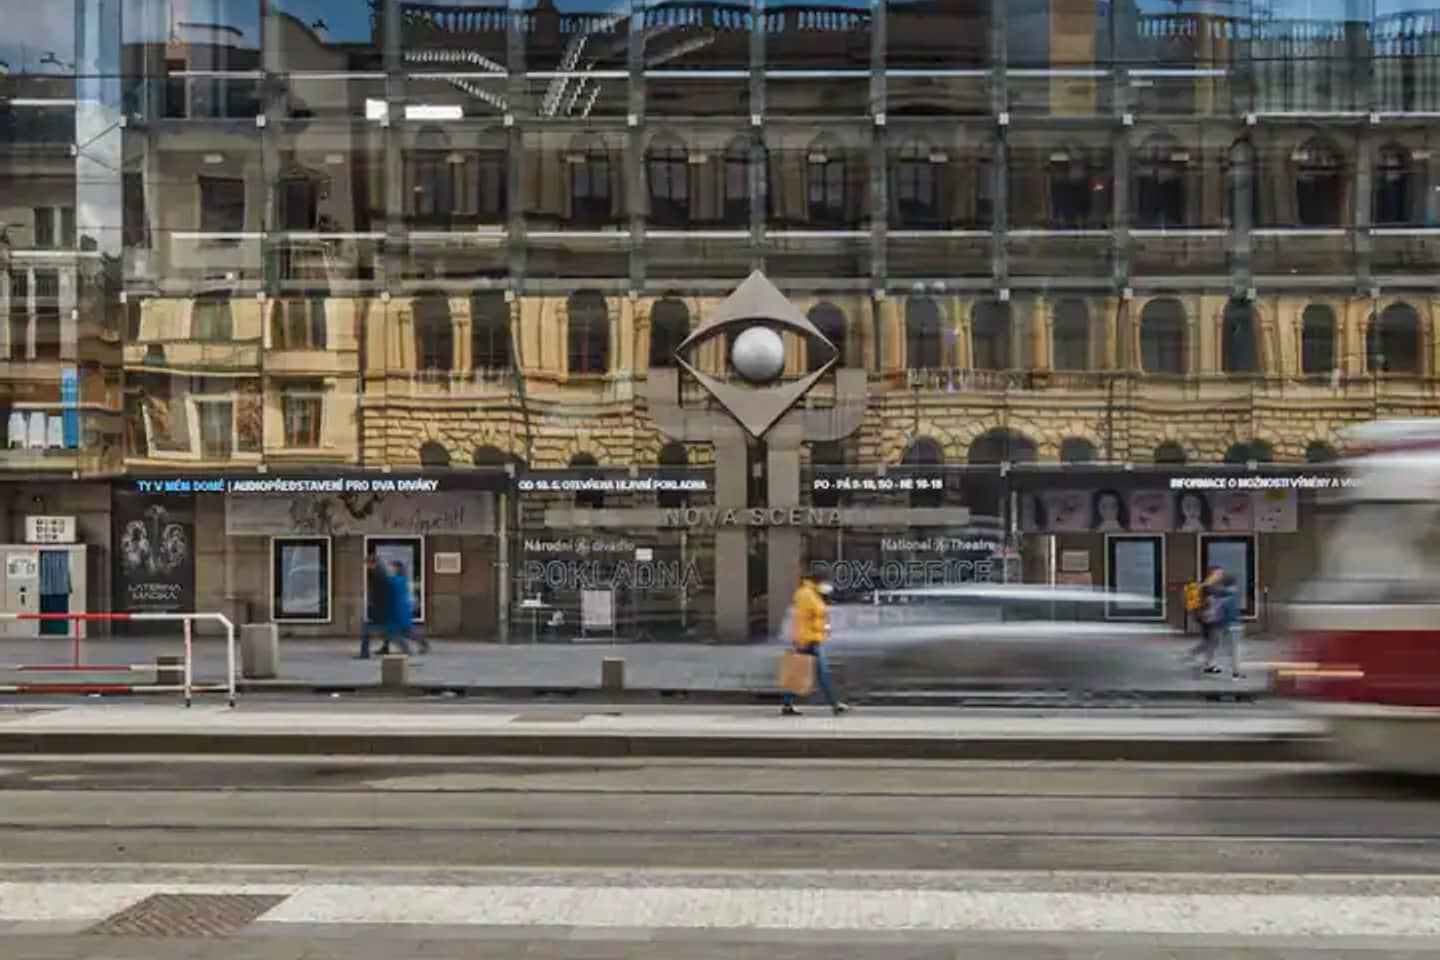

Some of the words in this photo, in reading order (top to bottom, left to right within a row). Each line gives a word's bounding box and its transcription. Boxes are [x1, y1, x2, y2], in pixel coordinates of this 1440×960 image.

[137, 479, 152, 491] TY
[346, 479, 370, 491] PRO
[372, 479, 396, 491] DVA
[397, 477, 439, 491] DIVÁKY
[813, 479, 830, 489] PO
[1228, 478, 1237, 489] O
[881, 539, 931, 551] National
[951, 539, 995, 551] Theatre
[525, 560, 703, 590] POKLADNA
[879, 559, 993, 587] OFFICE
